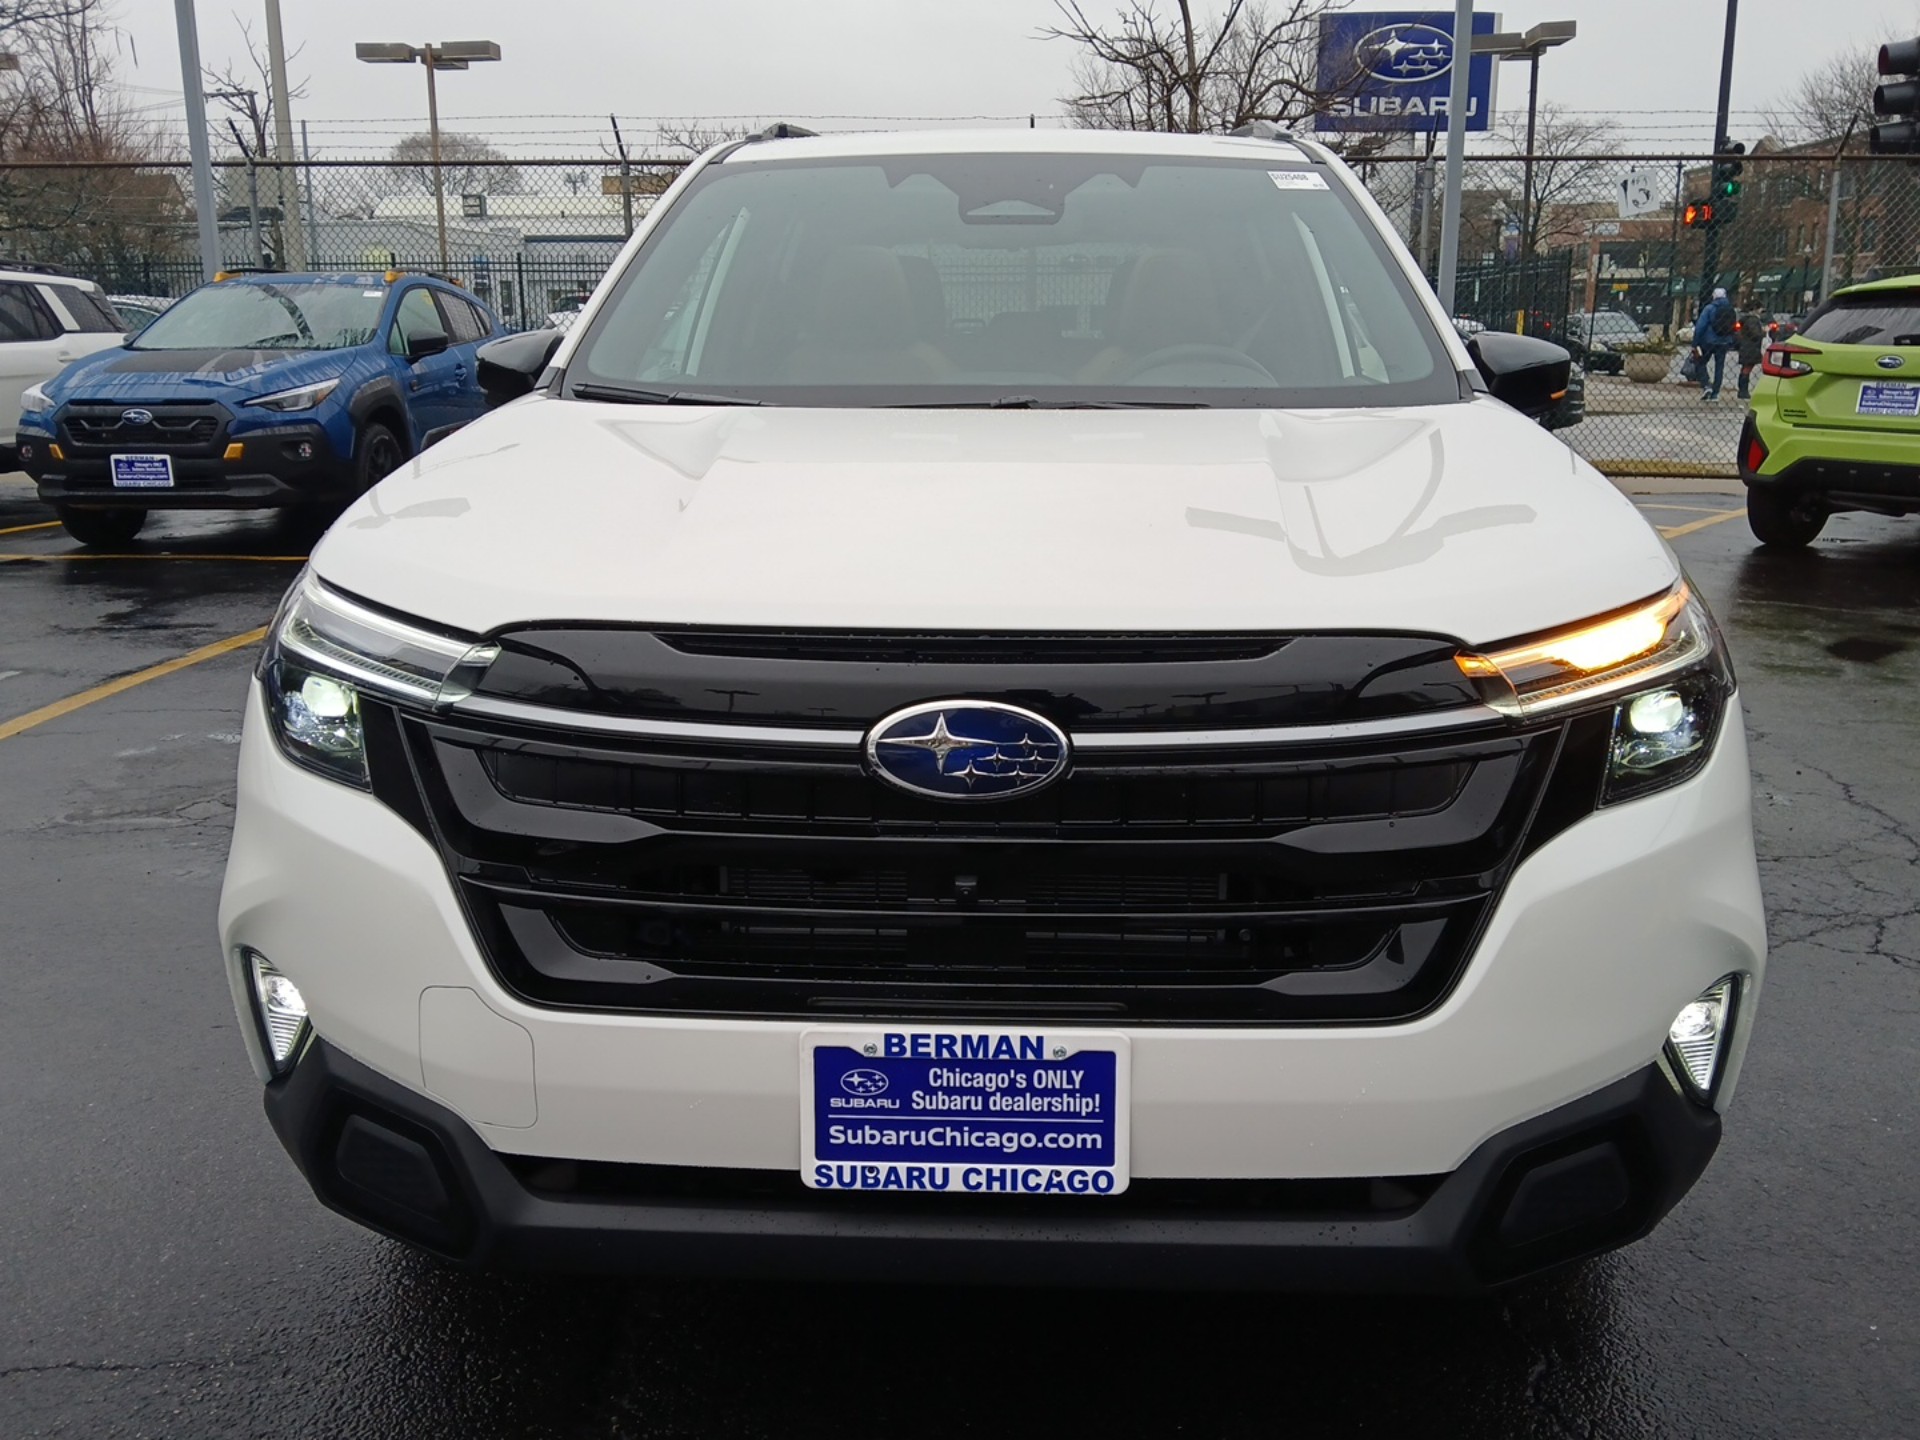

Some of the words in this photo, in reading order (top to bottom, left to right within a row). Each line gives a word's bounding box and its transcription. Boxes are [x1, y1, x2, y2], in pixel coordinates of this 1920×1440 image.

[883, 1033, 1044, 1060] BERMAN
[928, 1067, 1027, 1092] Chicago's
[1032, 1069, 1084, 1090] ONLY
[829, 1097, 900, 1109] SUBARU
[911, 1091, 983, 1112] Subaru
[988, 1092, 1101, 1116] dealership!
[828, 1125, 1103, 1153] SubaruChicago.com
[814, 1164, 950, 1190] SUBARU
[962, 1167, 1115, 1194] CHICAGO
